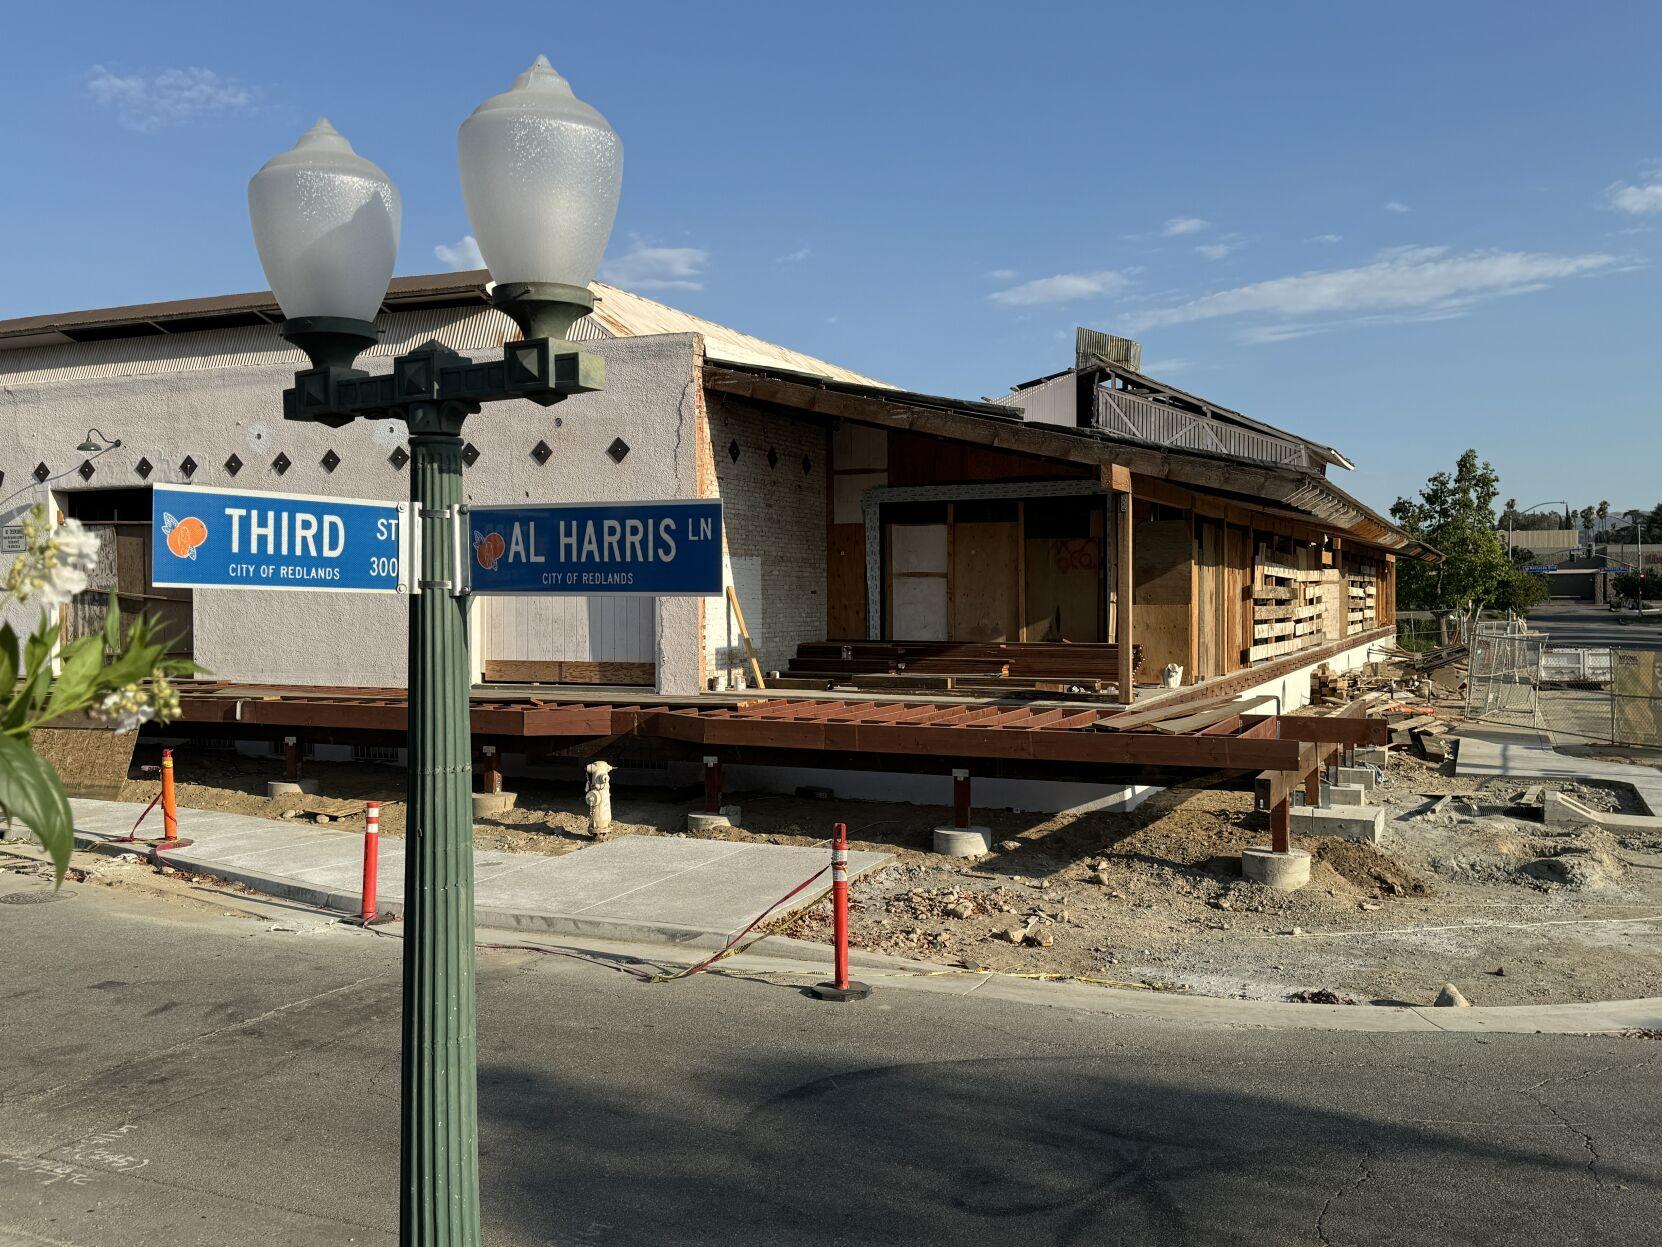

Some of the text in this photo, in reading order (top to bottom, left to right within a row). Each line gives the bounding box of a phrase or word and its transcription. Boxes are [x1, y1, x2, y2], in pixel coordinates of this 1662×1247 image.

[224, 507, 399, 558] THIRD ST
[507, 517, 712, 563] AL HARRIS LN
[228, 563, 340, 580] CITY OF REDLANDS
[369, 556, 399, 577] 300
[542, 572, 634, 585] CITY OF REDLANDS
